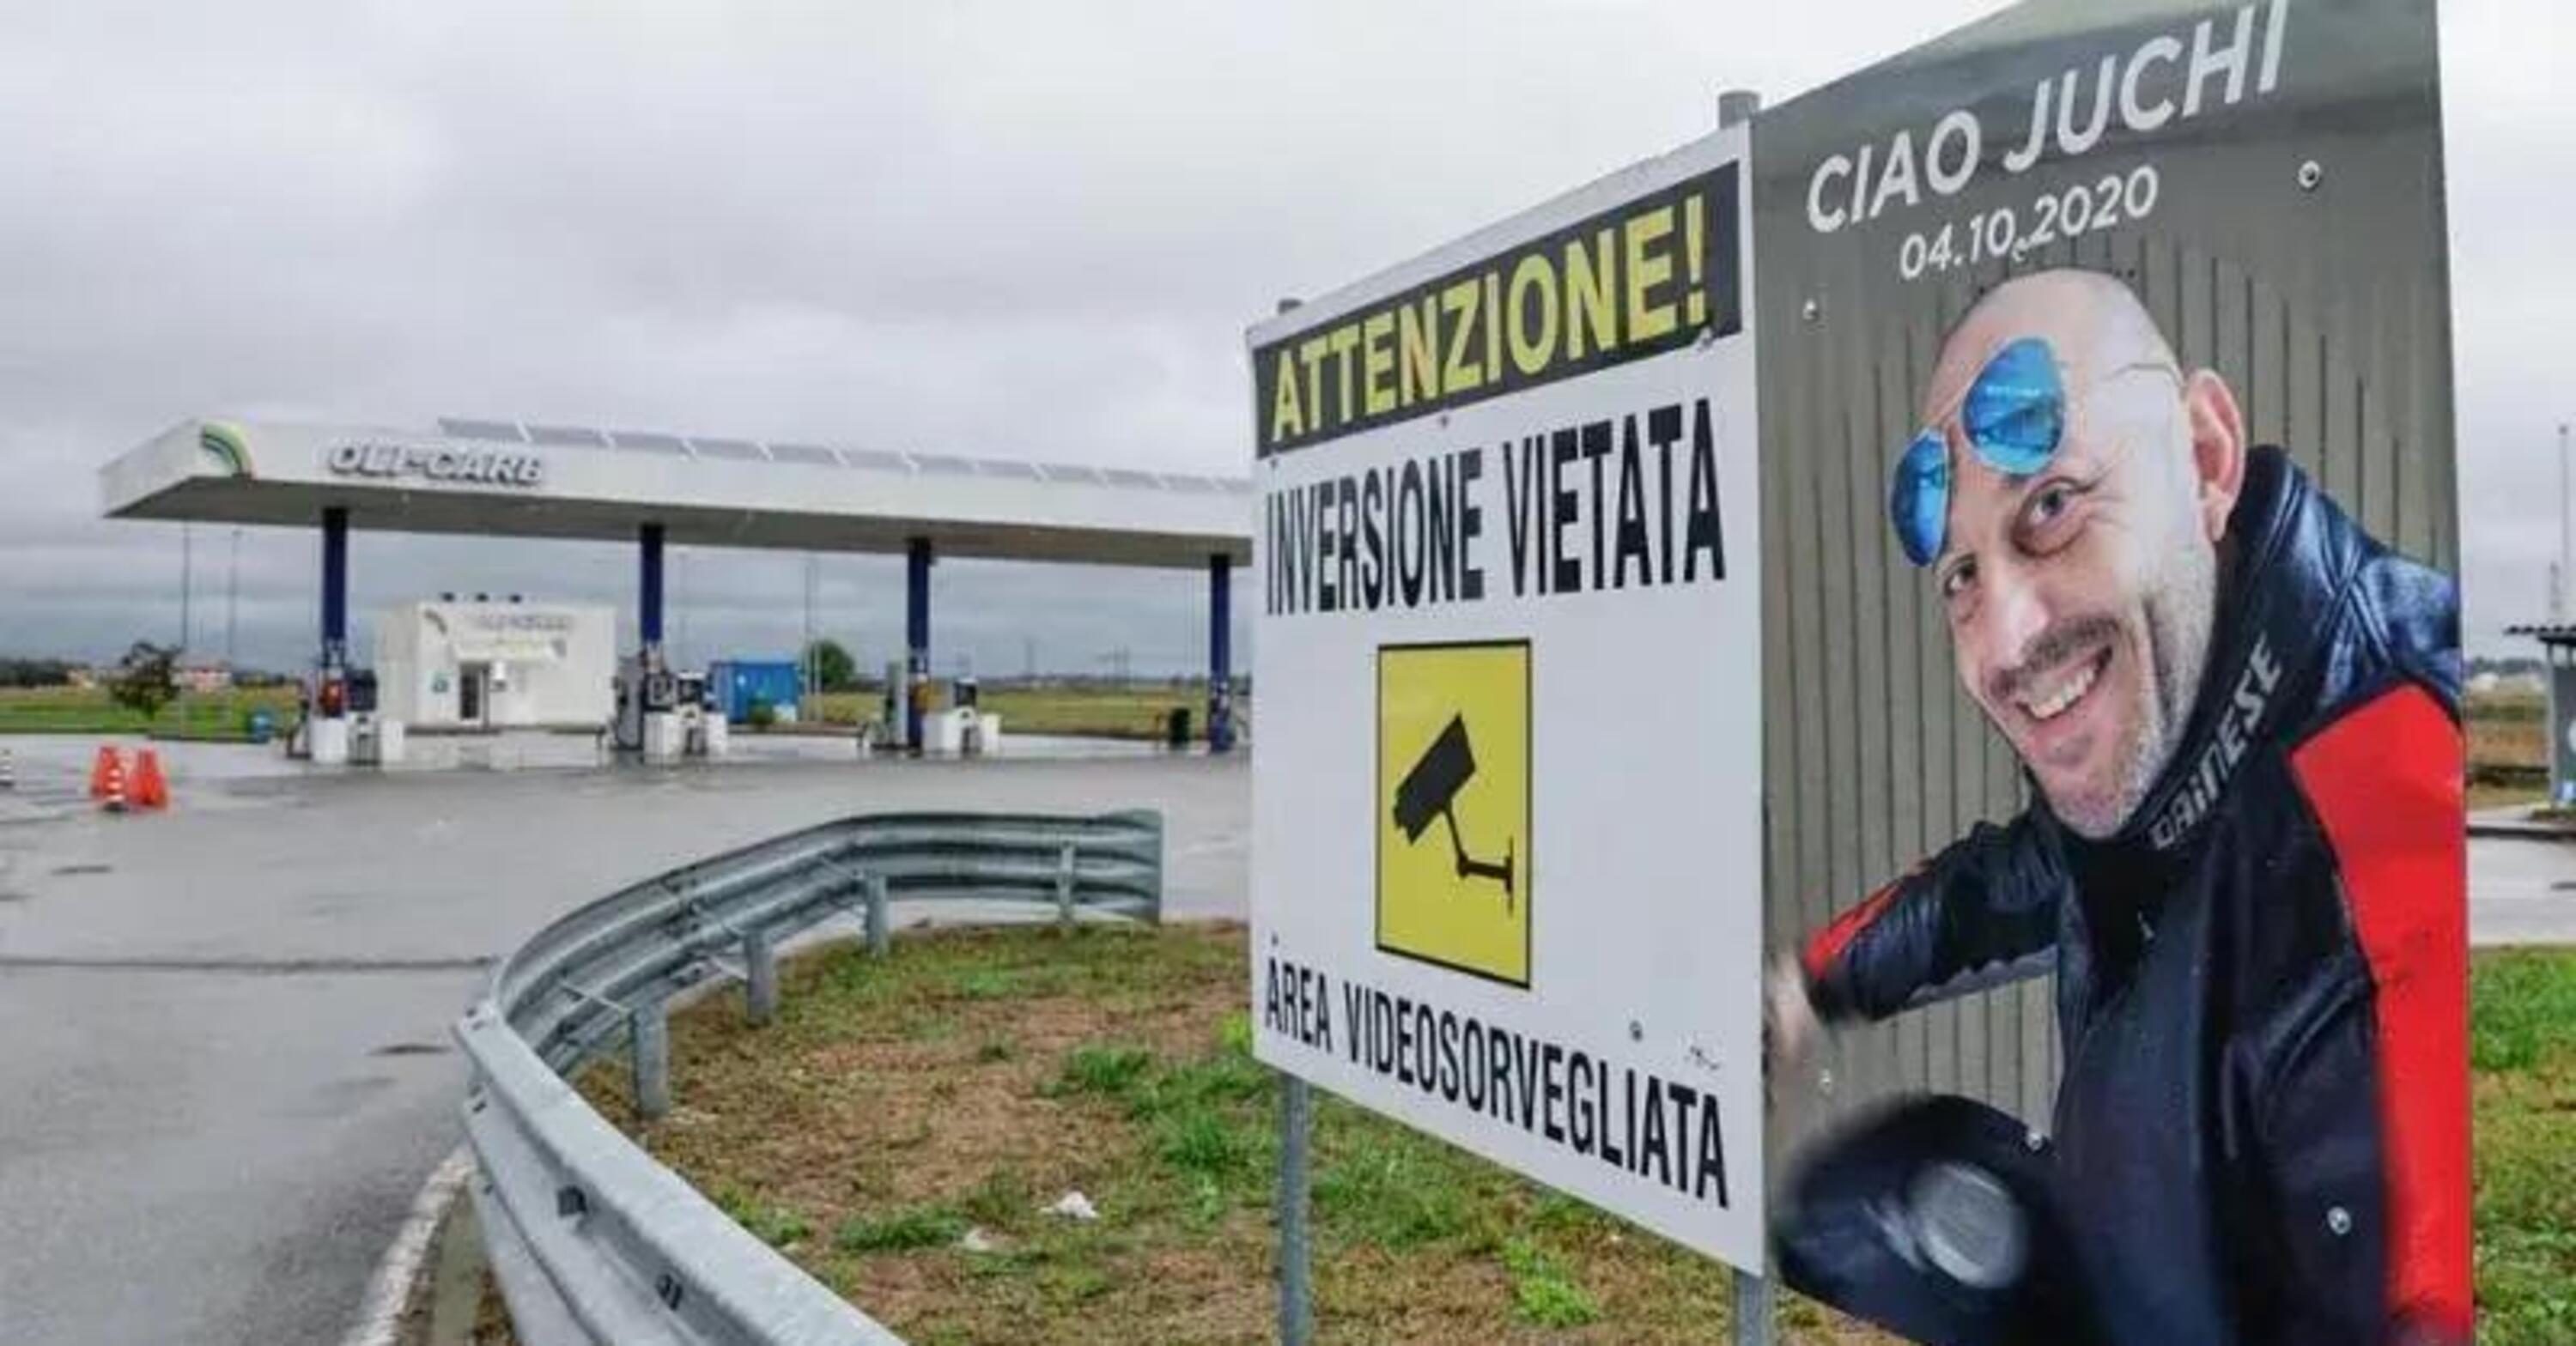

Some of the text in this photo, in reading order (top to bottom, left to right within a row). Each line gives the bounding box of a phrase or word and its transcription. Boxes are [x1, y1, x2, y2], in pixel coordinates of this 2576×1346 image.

[1807, 0, 2287, 233] CIAO JUCHI
[1899, 166, 2159, 279] 04.10.2020
[1273, 194, 1709, 442] ATTENZIONE!
[1267, 397, 1726, 616] INVERSIONE VIETATA
[1264, 956, 1729, 1209] AREA VIDEOSORVEGLIATA
